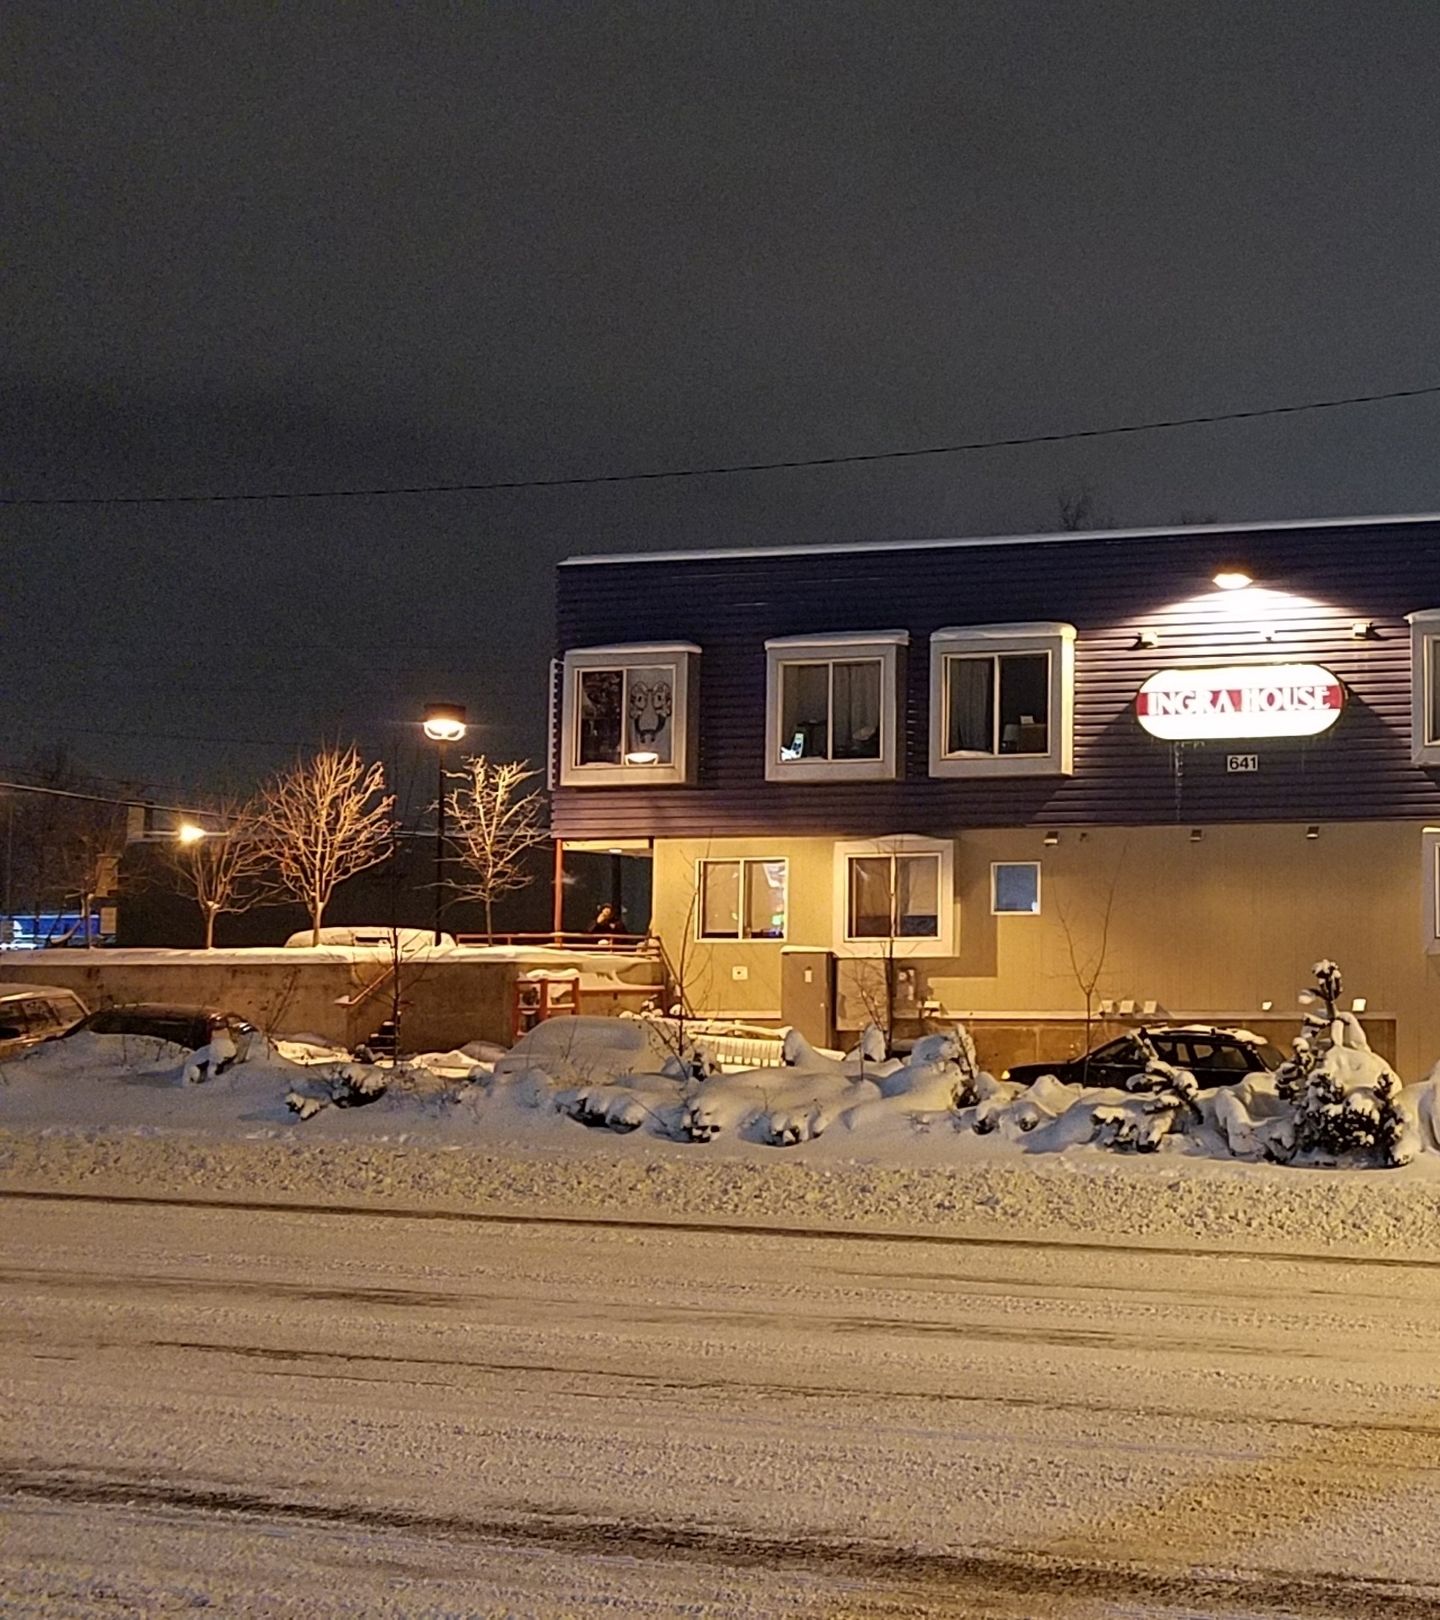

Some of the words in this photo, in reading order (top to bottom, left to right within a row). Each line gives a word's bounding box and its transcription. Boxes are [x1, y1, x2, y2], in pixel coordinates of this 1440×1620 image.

[1147, 690, 1235, 716] INGRA
[1241, 685, 1330, 713] HOUSE
[1229, 757, 1257, 770] 641
